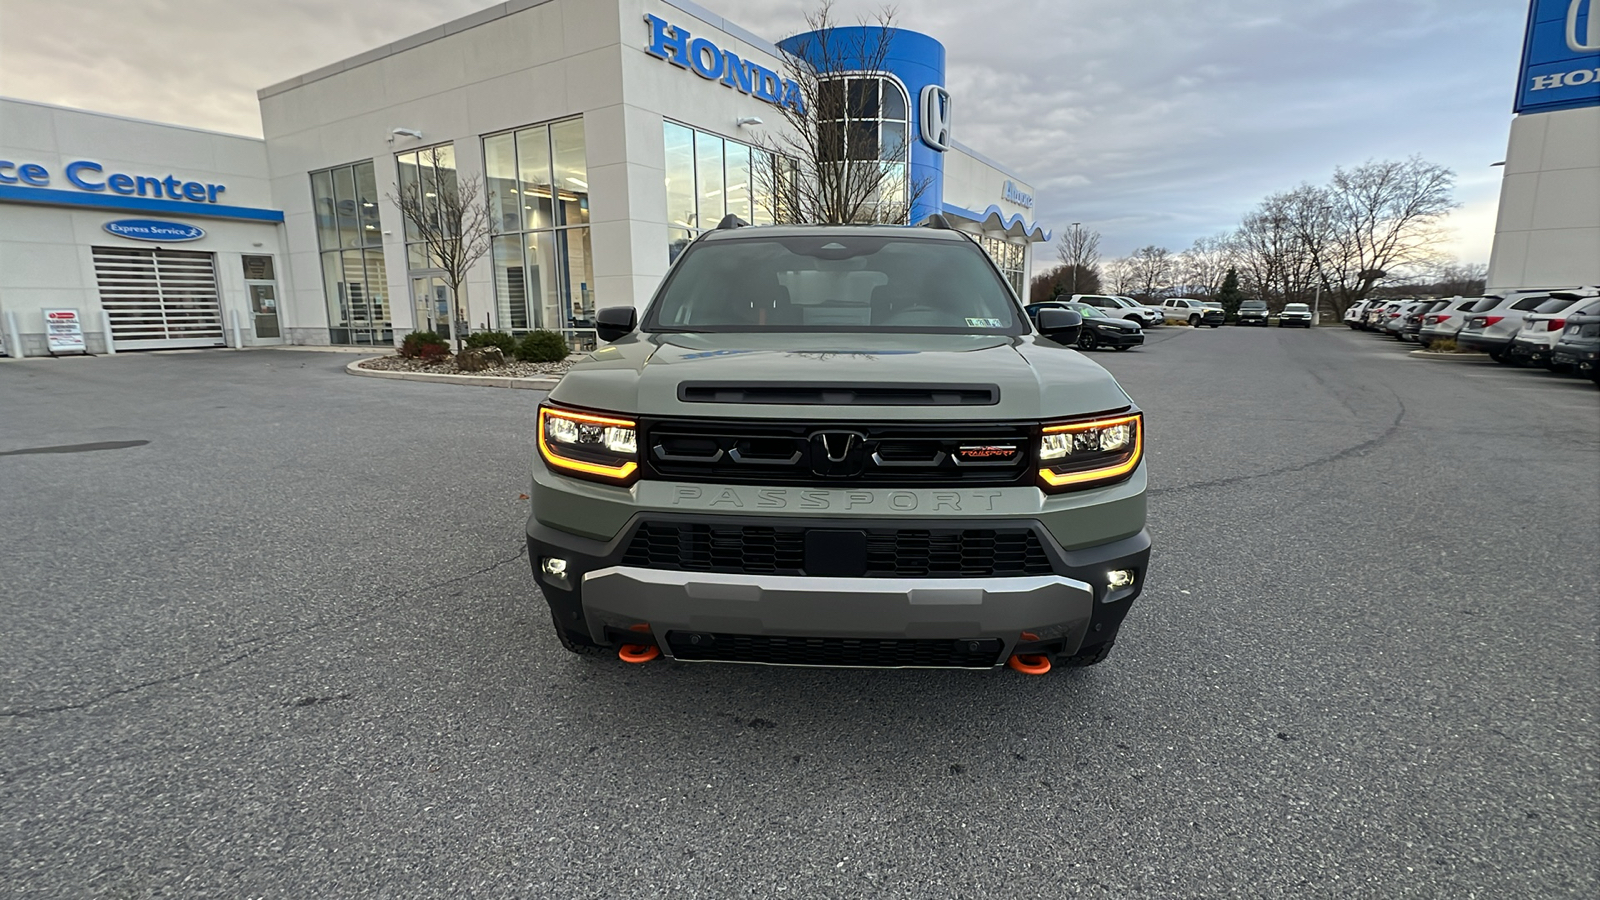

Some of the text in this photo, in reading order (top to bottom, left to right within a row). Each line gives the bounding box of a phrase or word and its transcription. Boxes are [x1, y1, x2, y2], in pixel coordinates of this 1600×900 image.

[644, 13, 807, 116] HONDA
[65, 160, 226, 203] Center
[110, 223, 186, 236] Express Service
[672, 485, 1002, 511] PASSPORT
